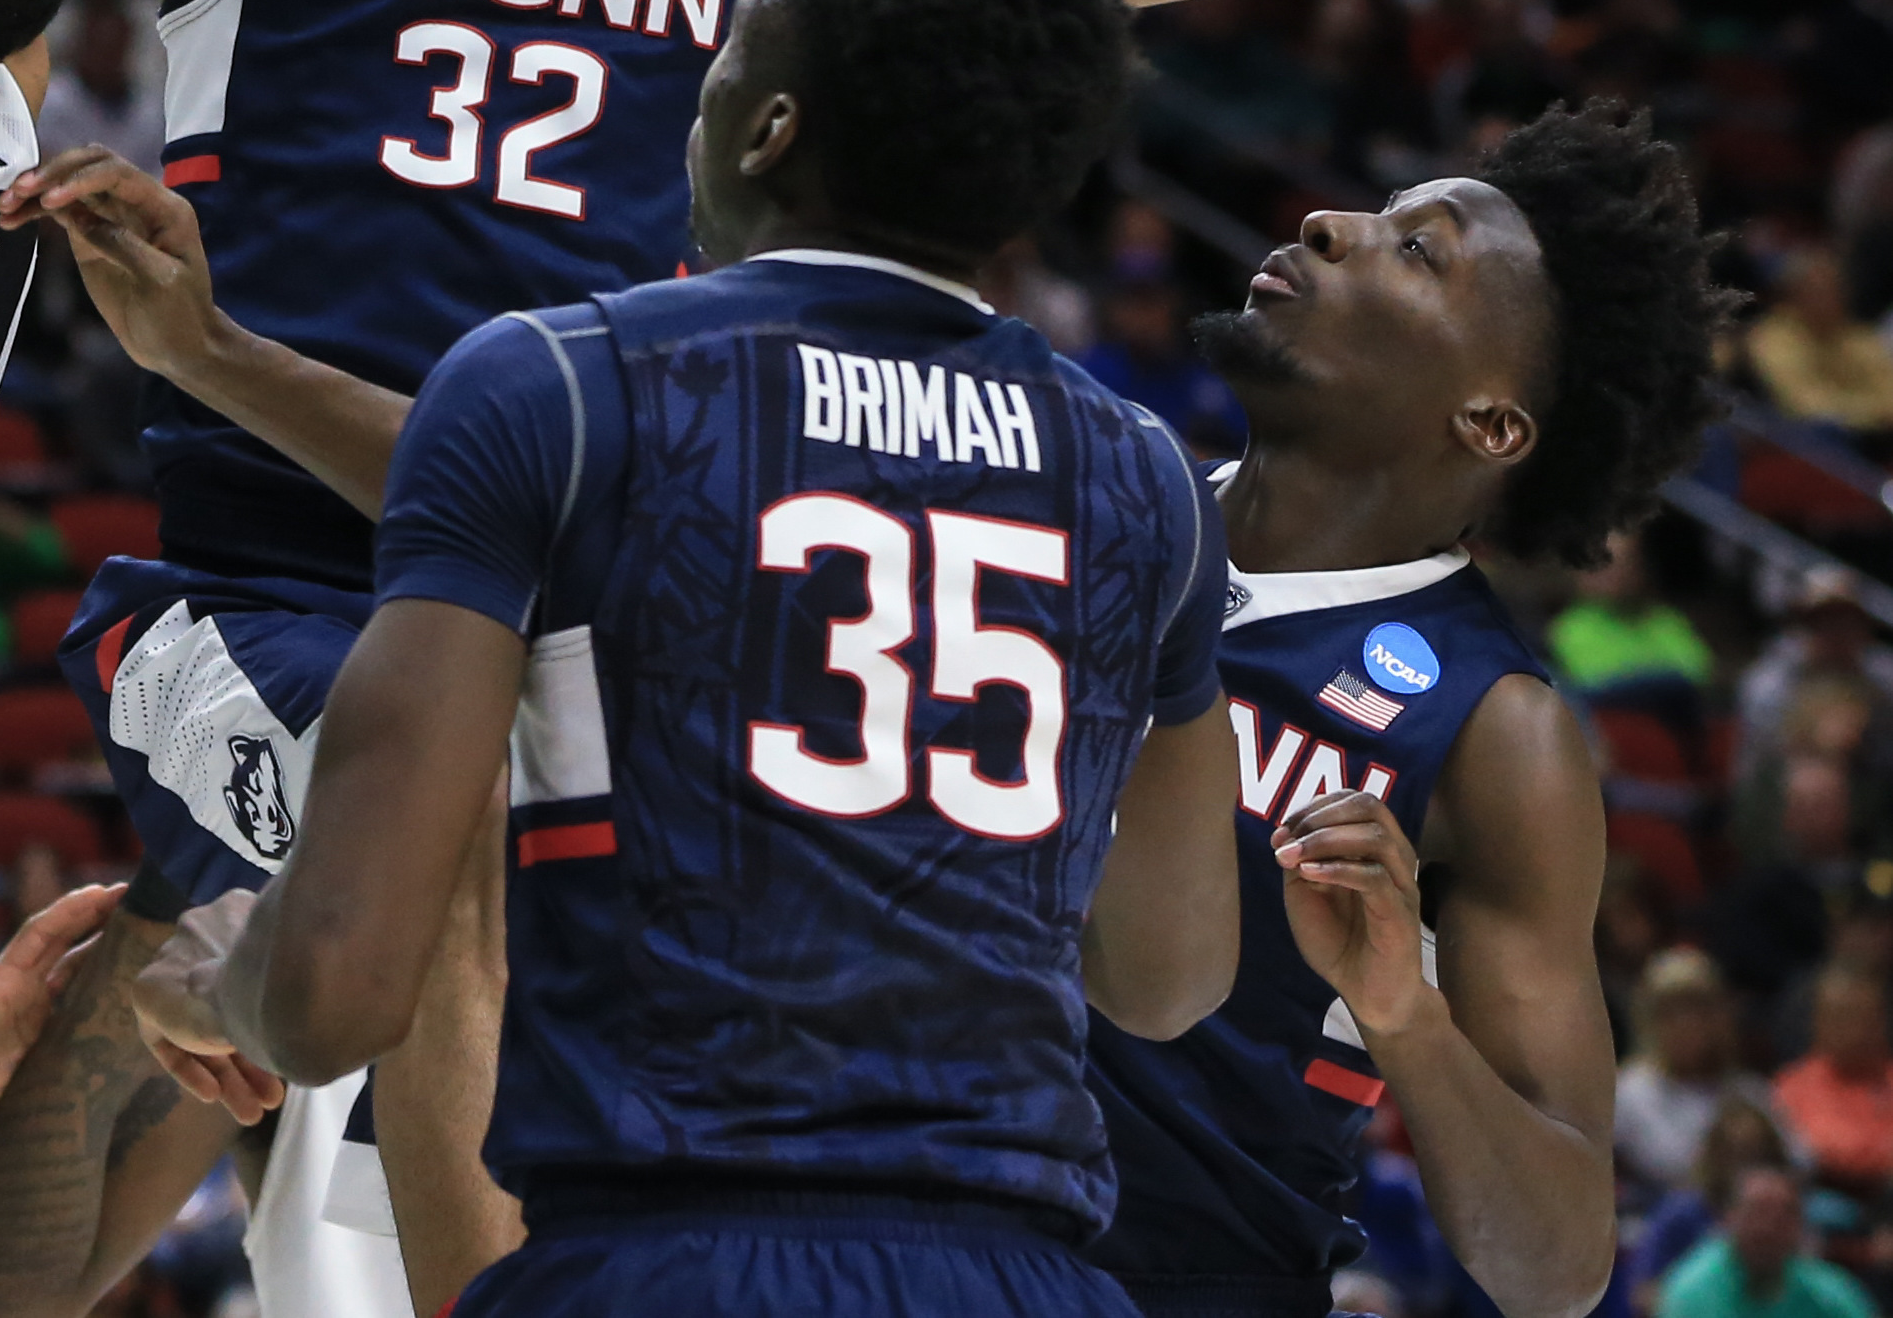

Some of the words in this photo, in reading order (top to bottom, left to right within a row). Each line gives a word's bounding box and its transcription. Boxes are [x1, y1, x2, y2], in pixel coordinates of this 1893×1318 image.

[379, 19, 609, 221] 32
[797, 343, 1041, 472] BRIMAH
[747, 490, 1070, 842] 35
[1368, 642, 1432, 690] NCAA
